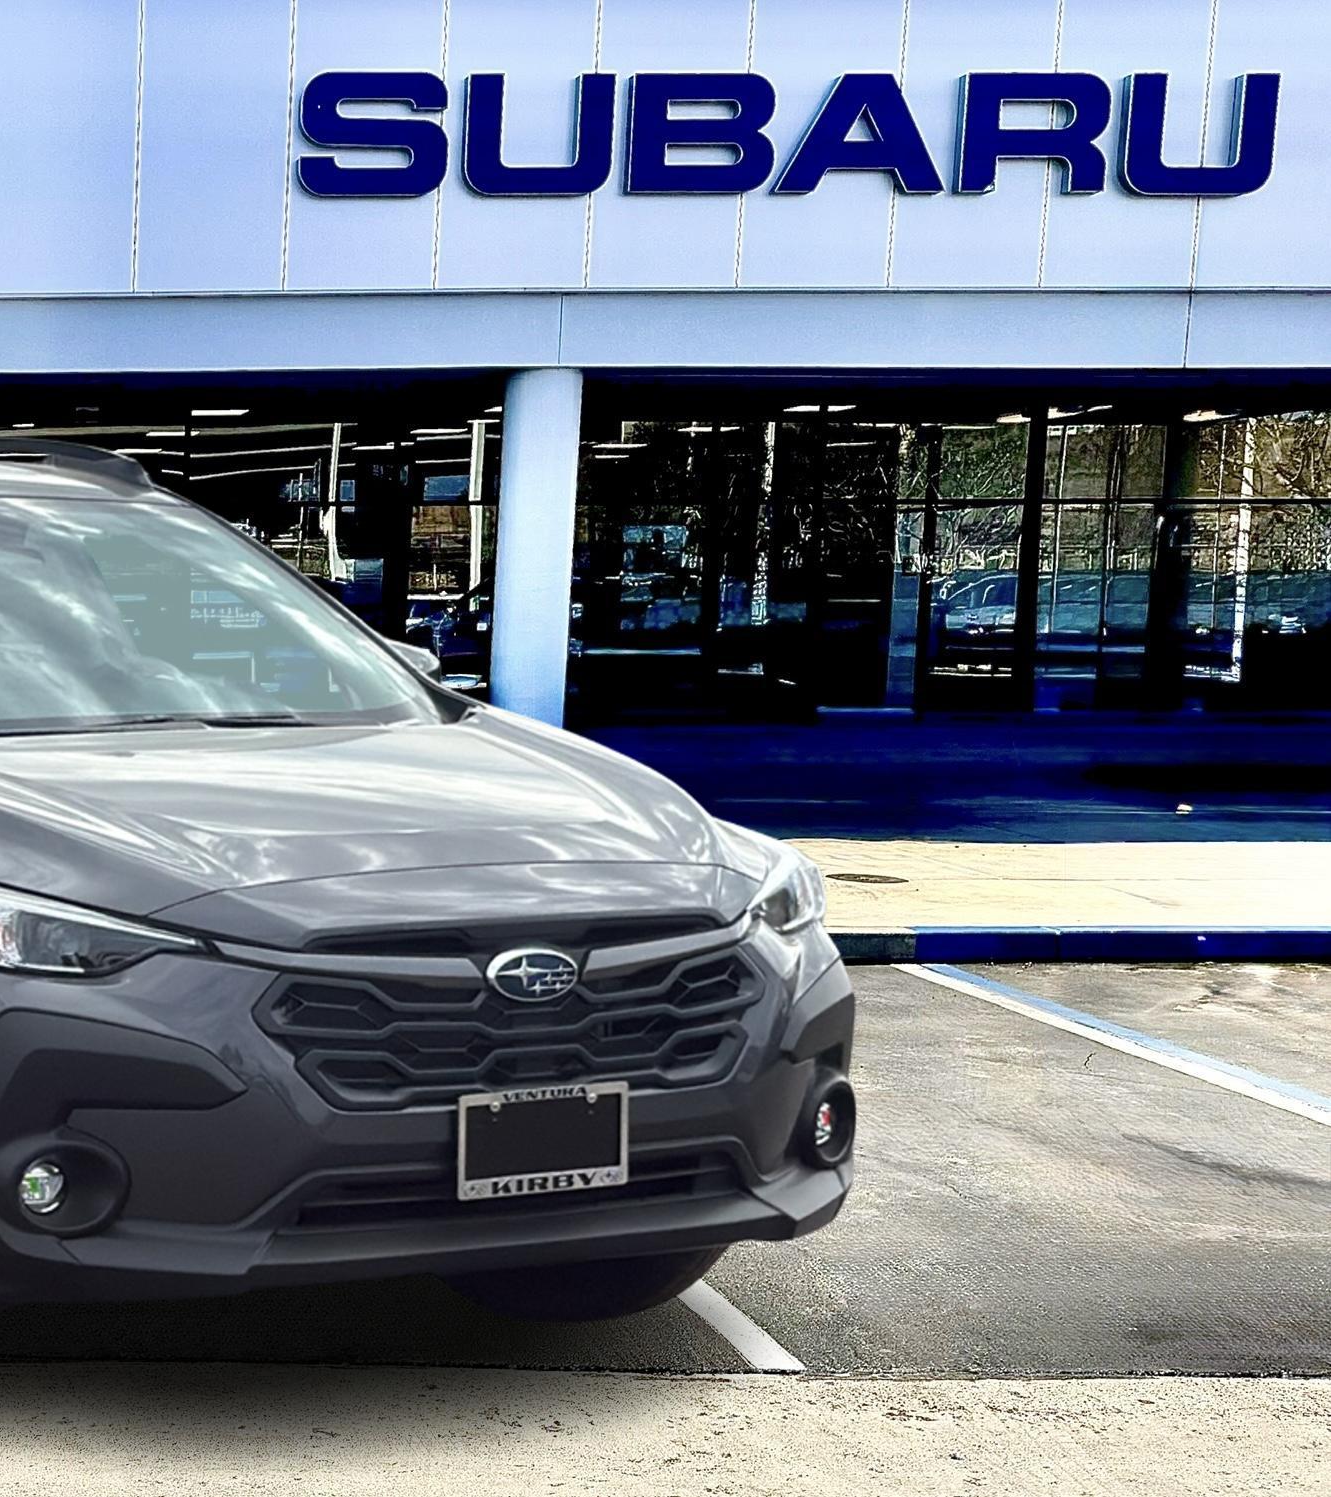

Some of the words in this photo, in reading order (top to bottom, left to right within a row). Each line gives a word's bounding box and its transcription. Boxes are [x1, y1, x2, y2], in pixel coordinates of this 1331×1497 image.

[296, 71, 1281, 198] SUBARU
[503, 1087, 587, 1102] VENTURA
[492, 1172, 598, 1194] KIRBY
